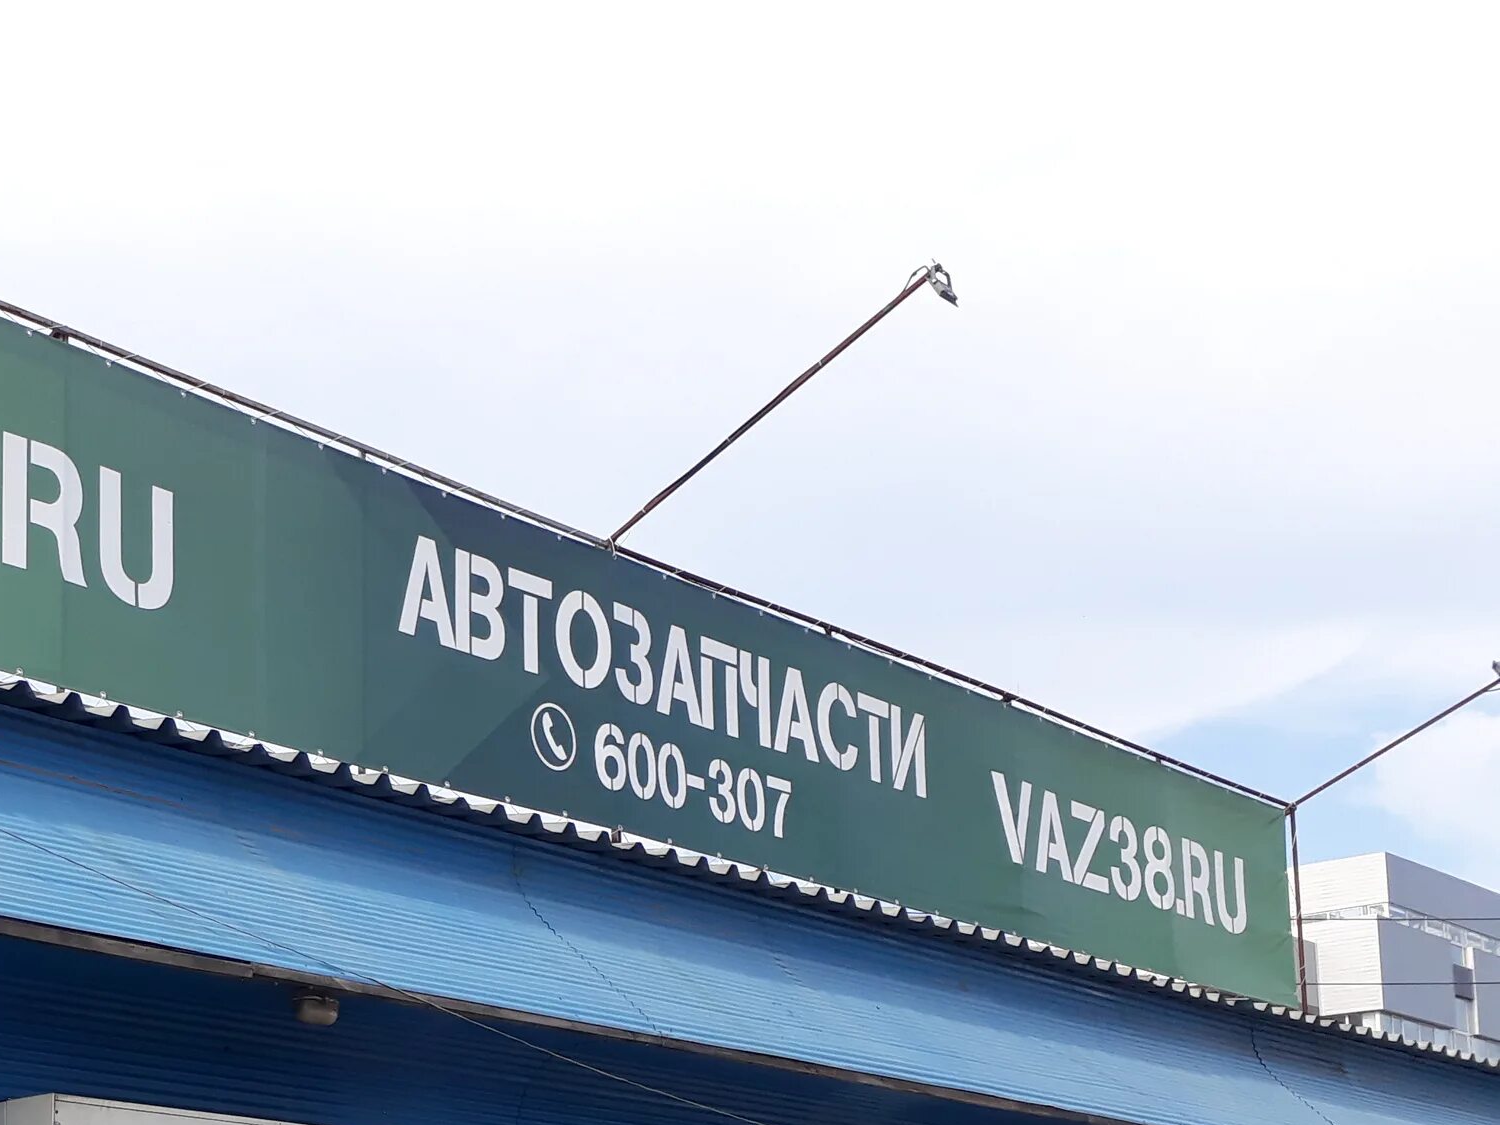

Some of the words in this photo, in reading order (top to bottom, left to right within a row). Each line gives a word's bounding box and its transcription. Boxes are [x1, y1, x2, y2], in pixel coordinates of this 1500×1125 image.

[398, 535, 927, 798] АВТОЗАПЧАСТИ
[595, 723, 791, 838] 600-307
[991, 770, 1247, 934] VAZ38.RU
